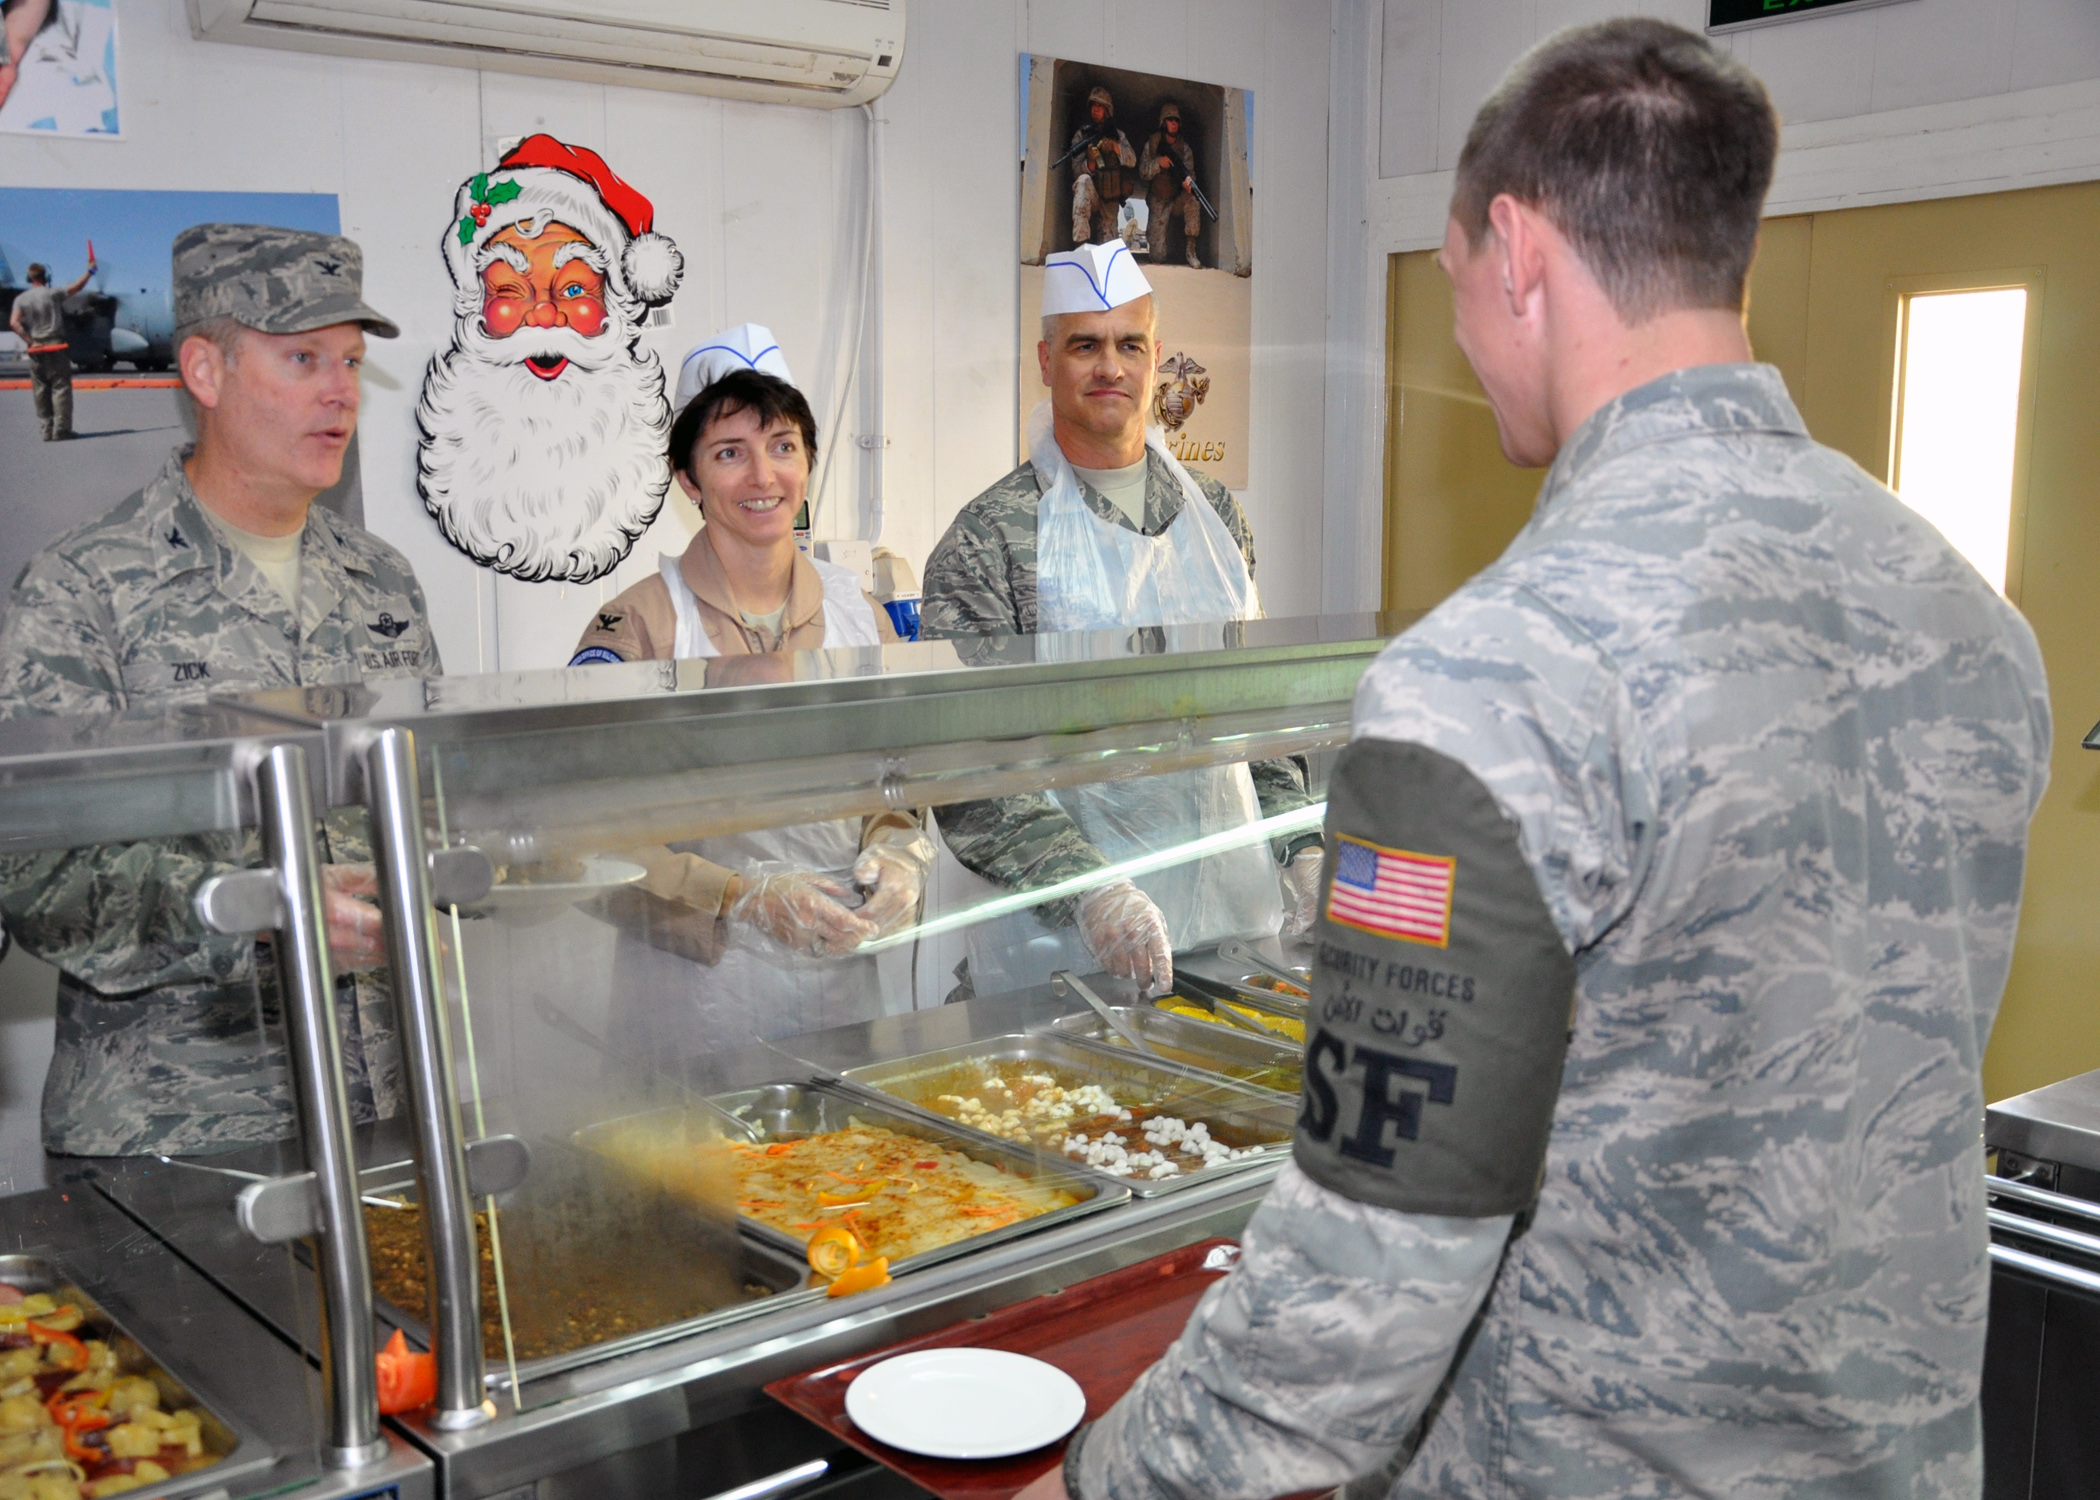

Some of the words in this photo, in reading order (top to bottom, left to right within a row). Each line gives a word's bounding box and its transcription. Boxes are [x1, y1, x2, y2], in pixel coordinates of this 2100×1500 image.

[1165, 432, 1225, 462] rines
[171, 662, 211, 682] ZICK
[382, 651, 403, 668] AIR
[1385, 961, 1476, 1003] FORCES
[1298, 1026, 1459, 1169] SF
